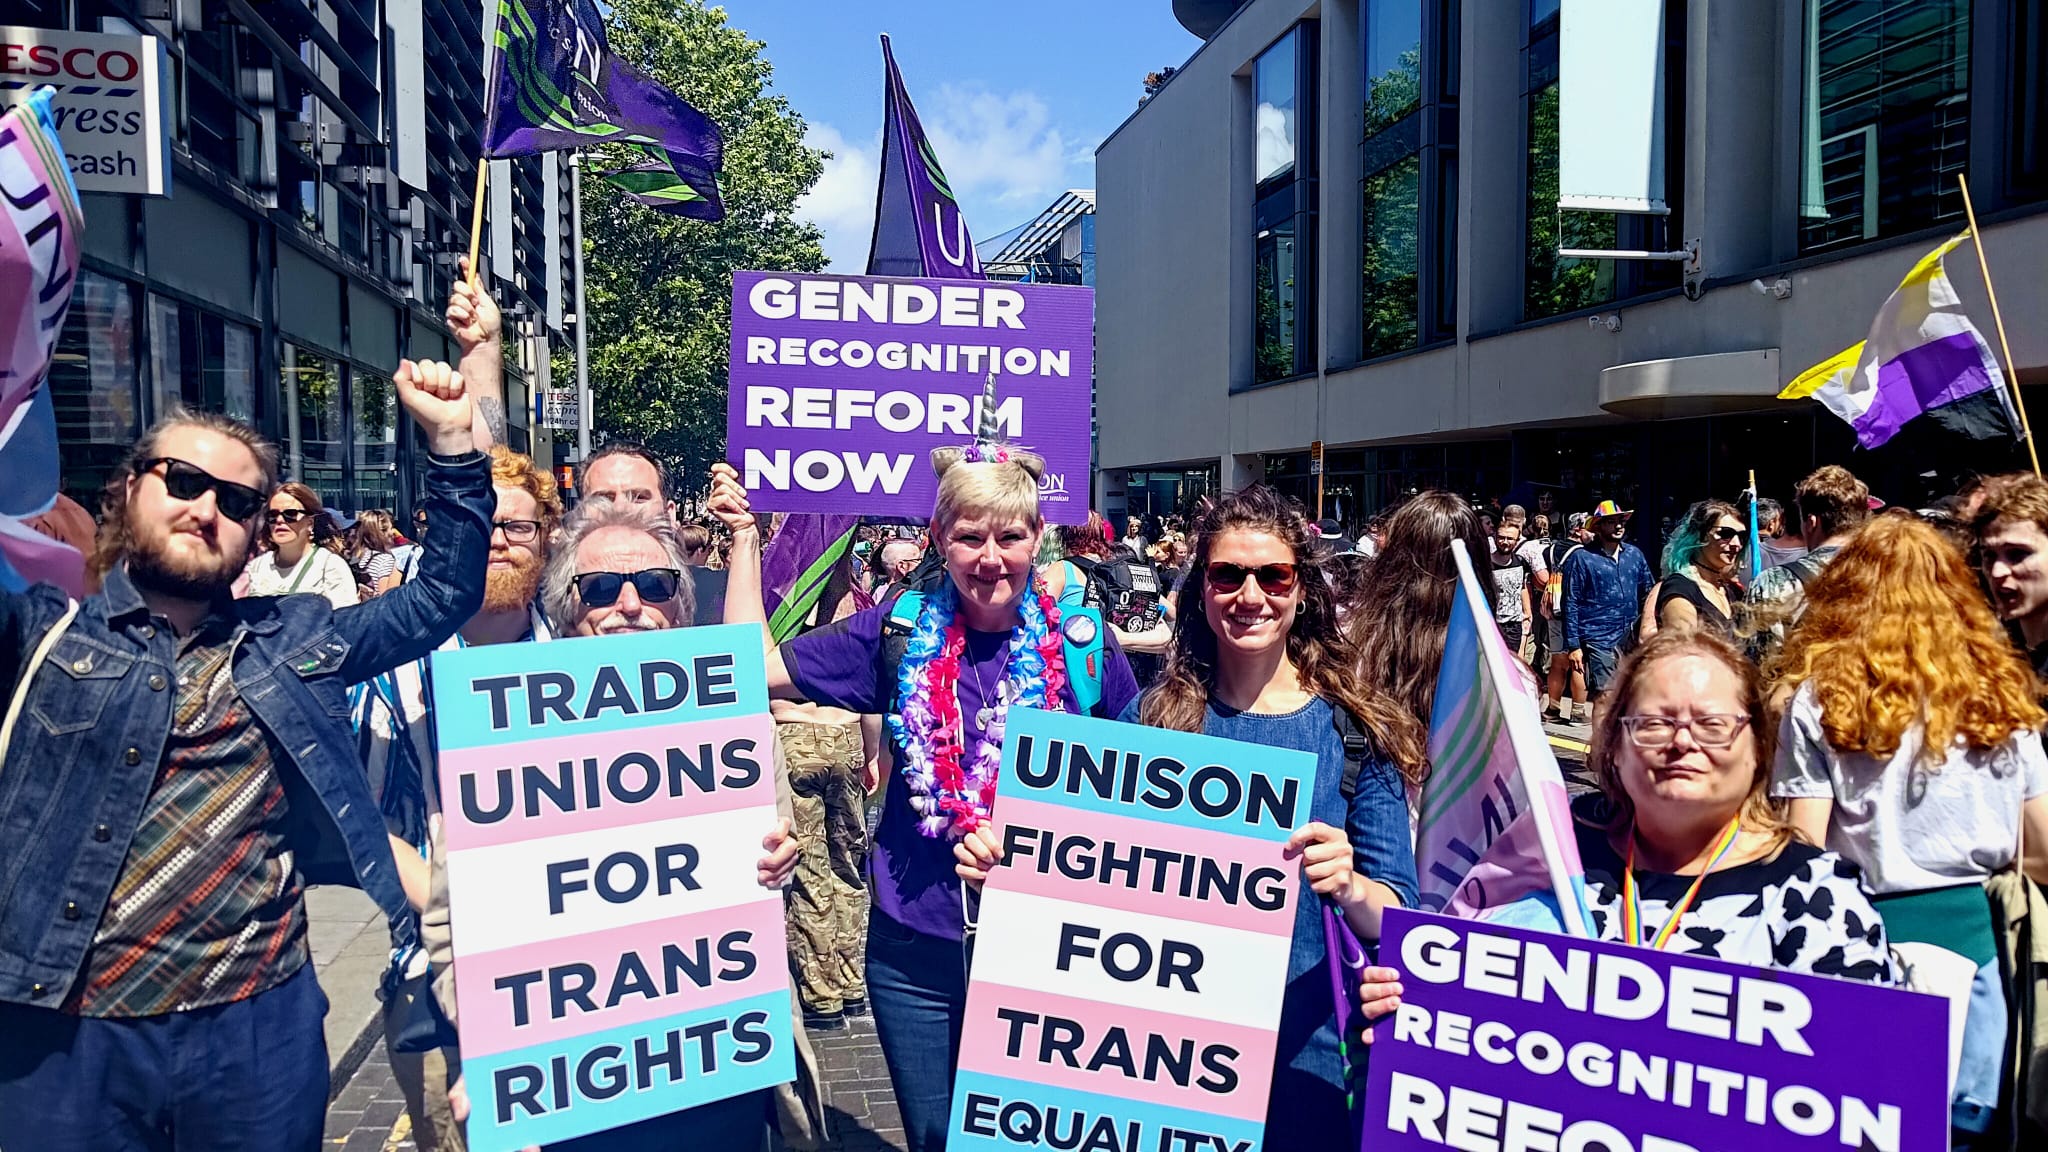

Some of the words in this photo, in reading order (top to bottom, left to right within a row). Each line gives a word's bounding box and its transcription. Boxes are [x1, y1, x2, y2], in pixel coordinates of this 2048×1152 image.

[748, 278, 1026, 331] GENDER
[746, 337, 1070, 377] RECOGNITION
[547, 392, 579, 402] TESC
[550, 417, 568, 425] 24hr
[746, 386, 1023, 438] REFORM
[743, 448, 915, 495] NOW
[472, 654, 737, 730] TRADE
[458, 738, 762, 826] UNIONS
[1014, 734, 1299, 830] UNISON
[546, 842, 702, 917] FOR
[999, 823, 1287, 913] FIGHTING
[494, 930, 758, 1028] TRANS
[1055, 922, 1205, 994] FOR
[1400, 924, 1815, 1057] GENDER
[493, 1010, 774, 1125] RIGHTS
[997, 1007, 1242, 1095] TRANS
[1393, 1002, 1901, 1152] RECOGNITION
